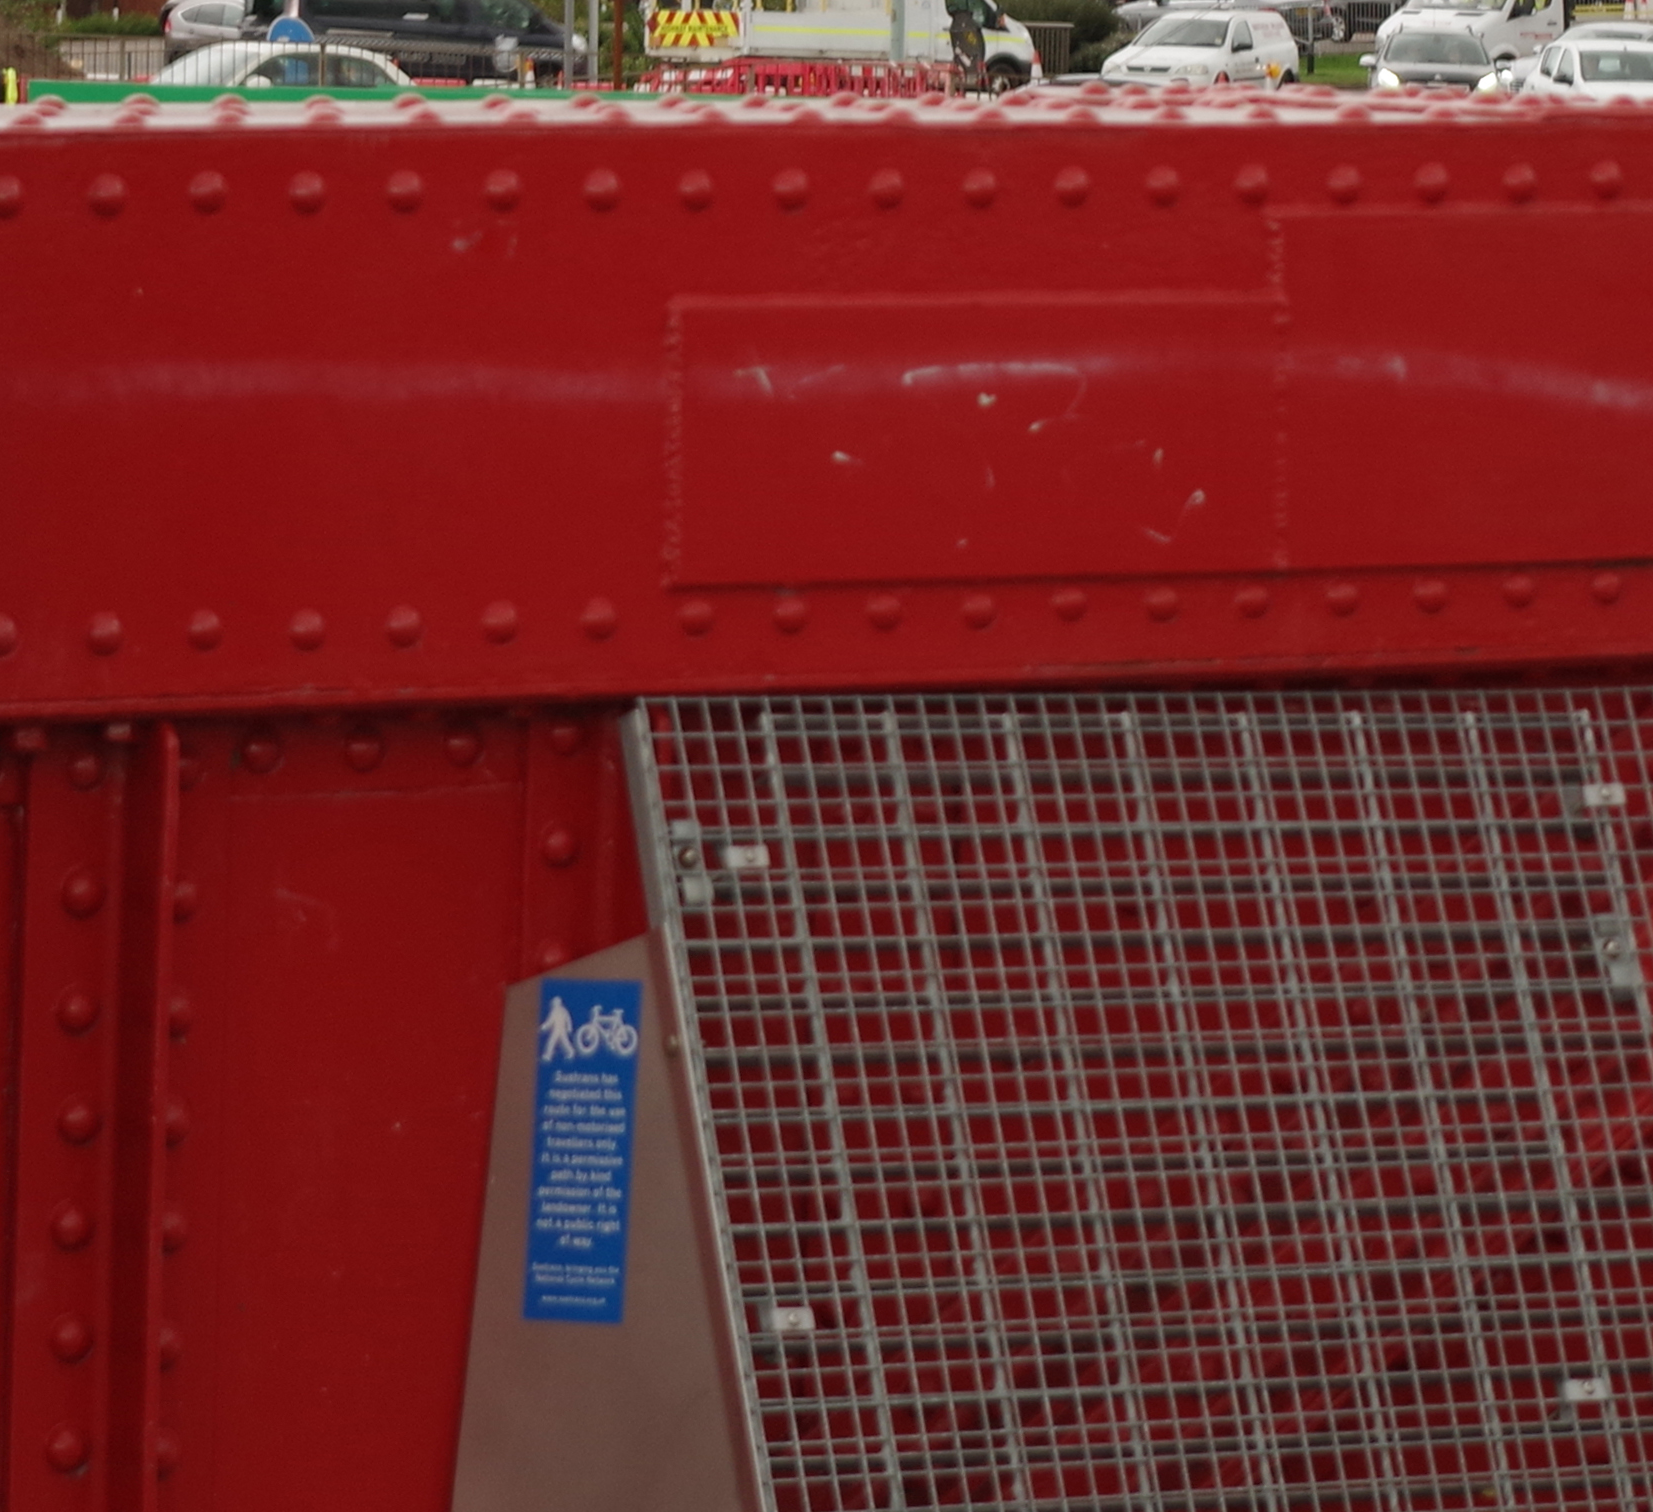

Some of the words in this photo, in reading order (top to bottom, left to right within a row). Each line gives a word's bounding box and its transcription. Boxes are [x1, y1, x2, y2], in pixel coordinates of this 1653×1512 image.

[554, 1069, 600, 1084] Sustrans
[601, 1071, 618, 1084] has
[548, 1088, 602, 1101] negotiated
[604, 1089, 623, 1101] this
[543, 1104, 571, 1116] route
[572, 1104, 587, 1116] for
[589, 1104, 606, 1117] the
[608, 1106, 627, 1118] use
[542, 1120, 554, 1132] of
[546, 1136, 594, 1149] travellers
[552, 1152, 562, 1164] is
[563, 1154, 570, 1164] a
[571, 1154, 624, 1167] permissive
[550, 1169, 575, 1182] path
[575, 1169, 588, 1183] by
[590, 1169, 613, 1182] kind
[538, 1184, 592, 1198] permission
[593, 1185, 604, 1198] of
[605, 1186, 623, 1199] the
[608, 1203, 618, 1215] is
[536, 1217, 554, 1230] not
[555, 1219, 562, 1229] a
[563, 1217, 594, 1231] public
[596, 1219, 621, 1235] right
[559, 1233, 571, 1246] of
